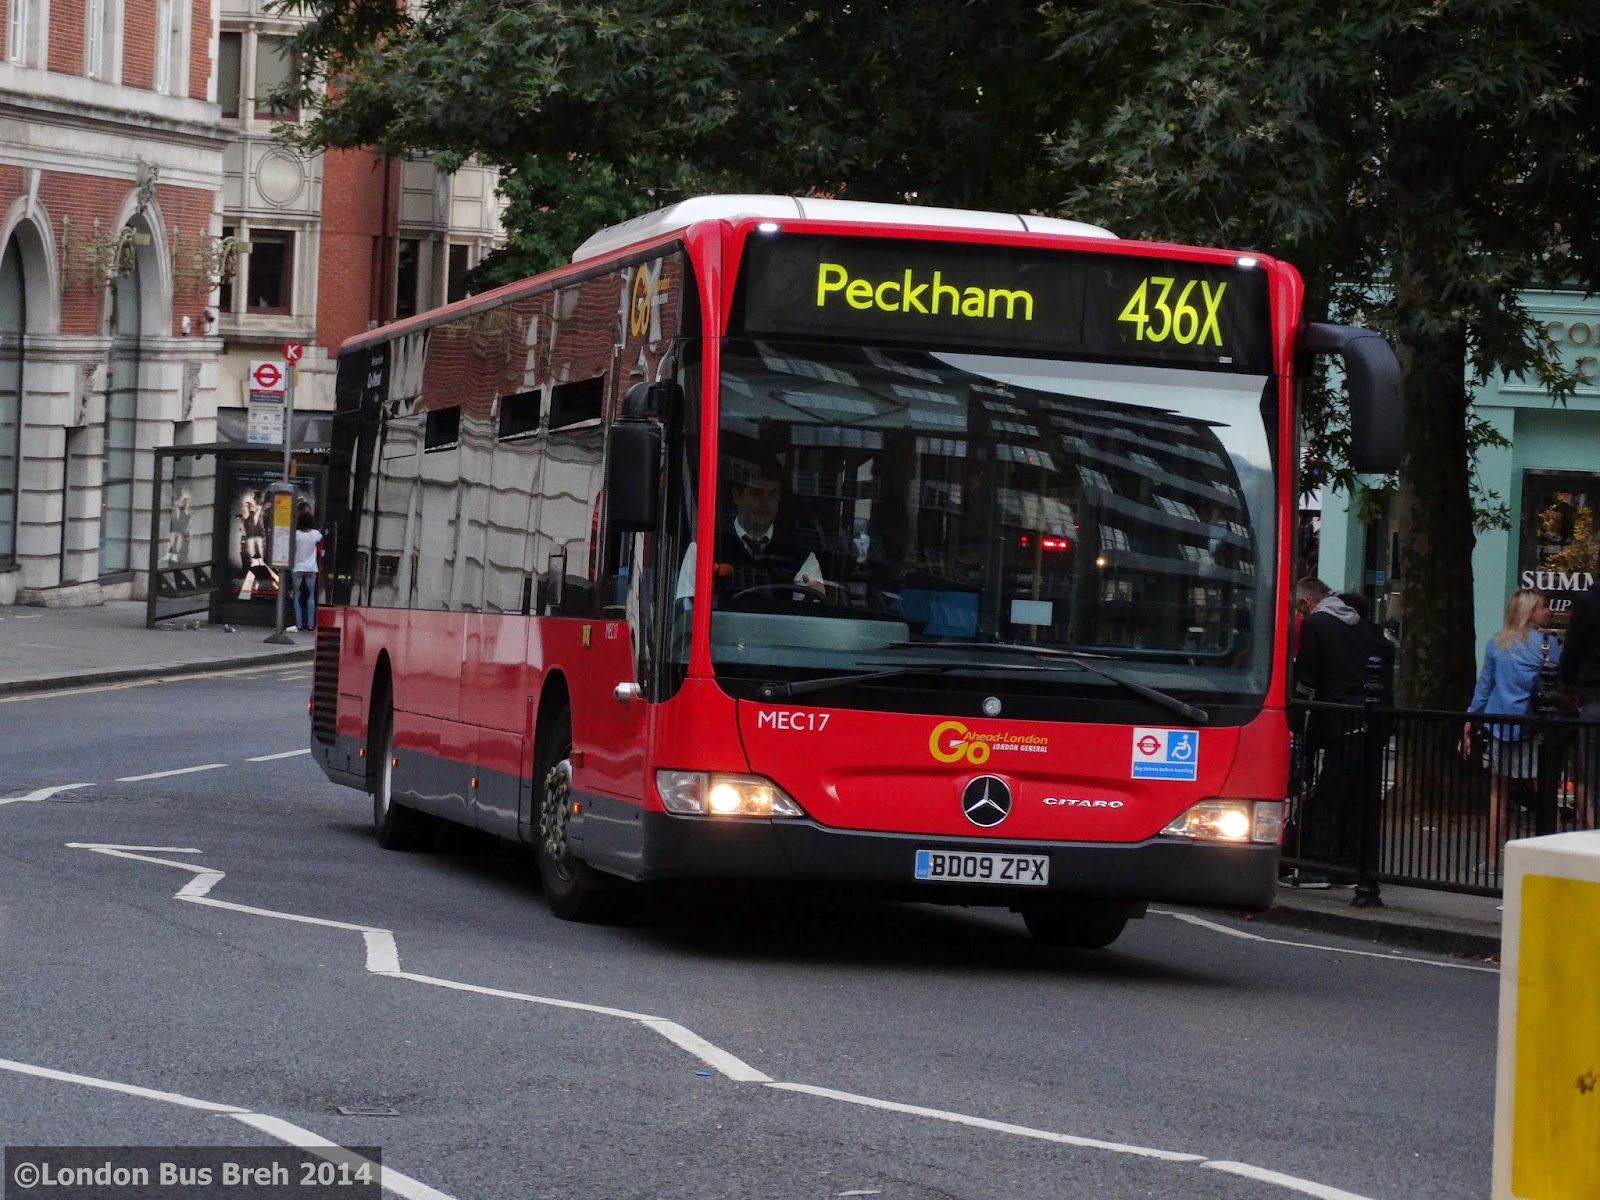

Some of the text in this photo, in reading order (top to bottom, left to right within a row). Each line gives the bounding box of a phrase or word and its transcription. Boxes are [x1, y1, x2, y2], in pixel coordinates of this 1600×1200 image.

[816, 263, 1228, 347] Peckham 436X
[1546, 321, 1600, 346] CO
[287, 344, 299, 359] K
[1548, 598, 1572, 612] UP
[757, 710, 830, 731] MEC17
[928, 720, 991, 765] Go
[963, 731, 1049, 745] Ahead-London
[992, 743, 1048, 753] LONDON GENERAL
[1042, 797, 1124, 808] CITARO
[931, 854, 1046, 881] BD09 ZPX
